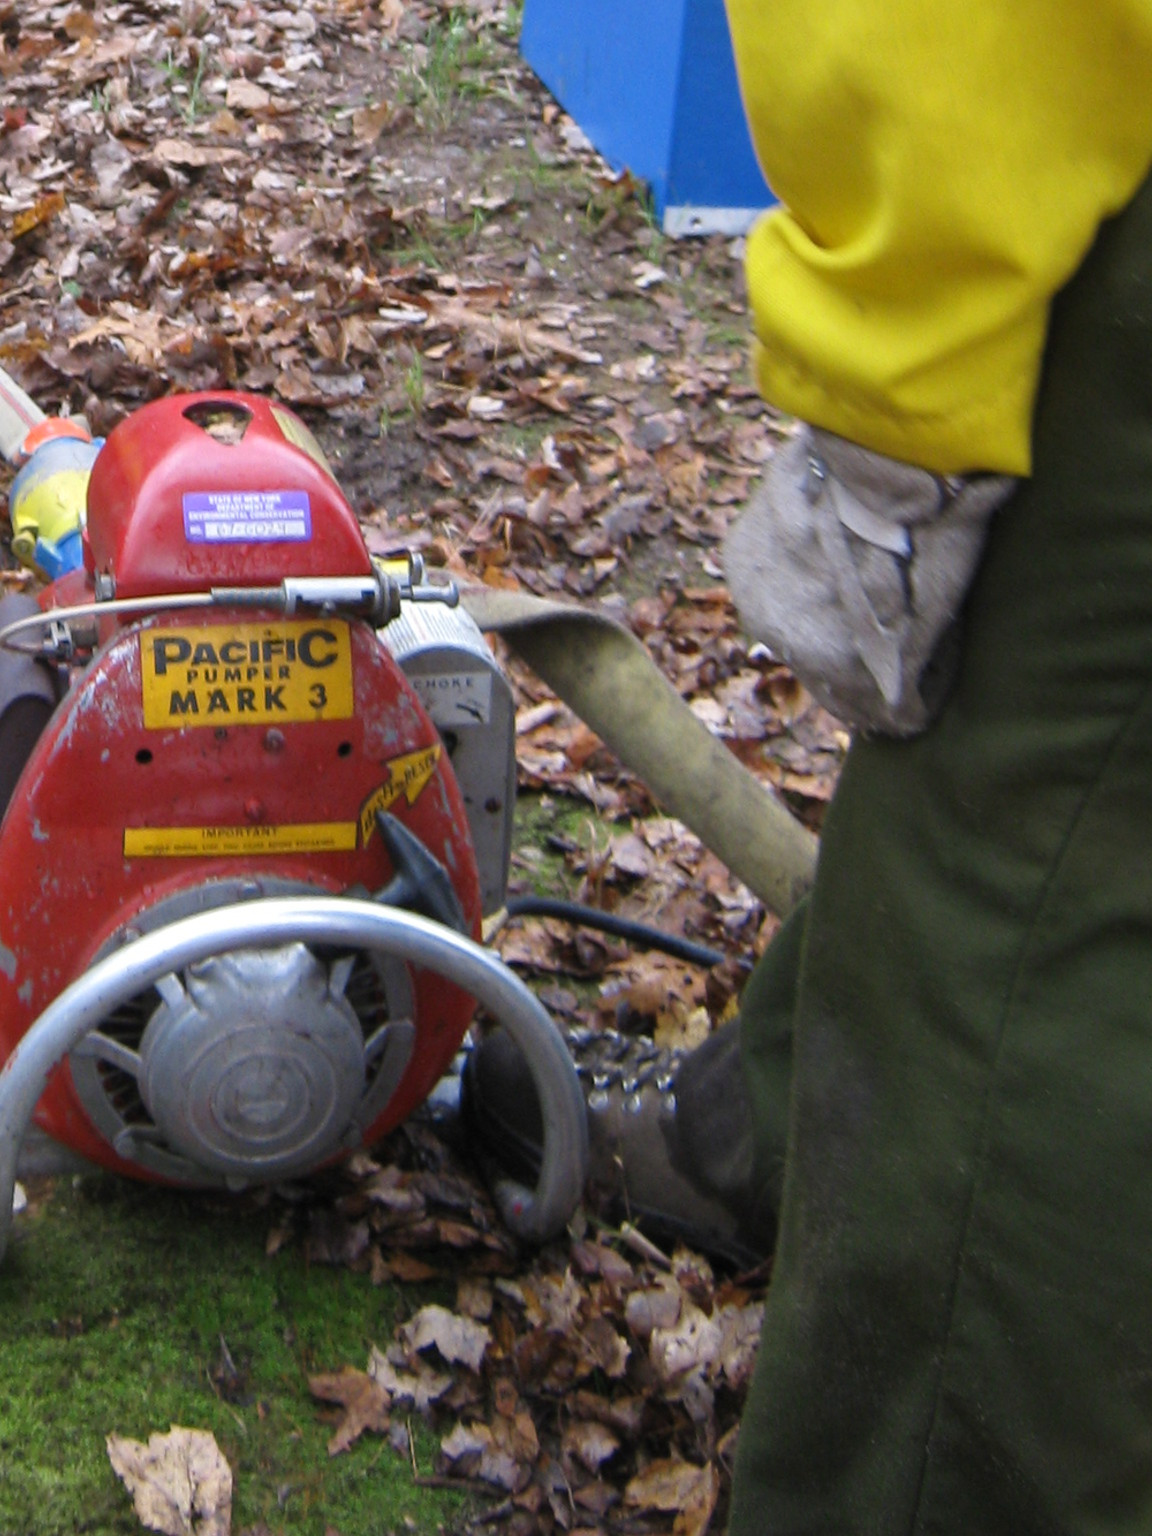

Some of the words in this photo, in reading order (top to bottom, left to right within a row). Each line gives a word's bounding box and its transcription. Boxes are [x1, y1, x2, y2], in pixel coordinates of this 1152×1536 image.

[208, 495, 231, 504] STATE
[243, 494, 260, 503] NEW
[261, 494, 281, 503] YORK
[249, 509, 304, 519] CONSERVATION
[153, 629, 338, 675] PACIFIC
[187, 666, 290, 683] PUMPER
[413, 677, 472, 689] CHOKE
[169, 685, 287, 715] MARK
[308, 683, 328, 708] 3
[202, 827, 277, 838] IMPORTANT
